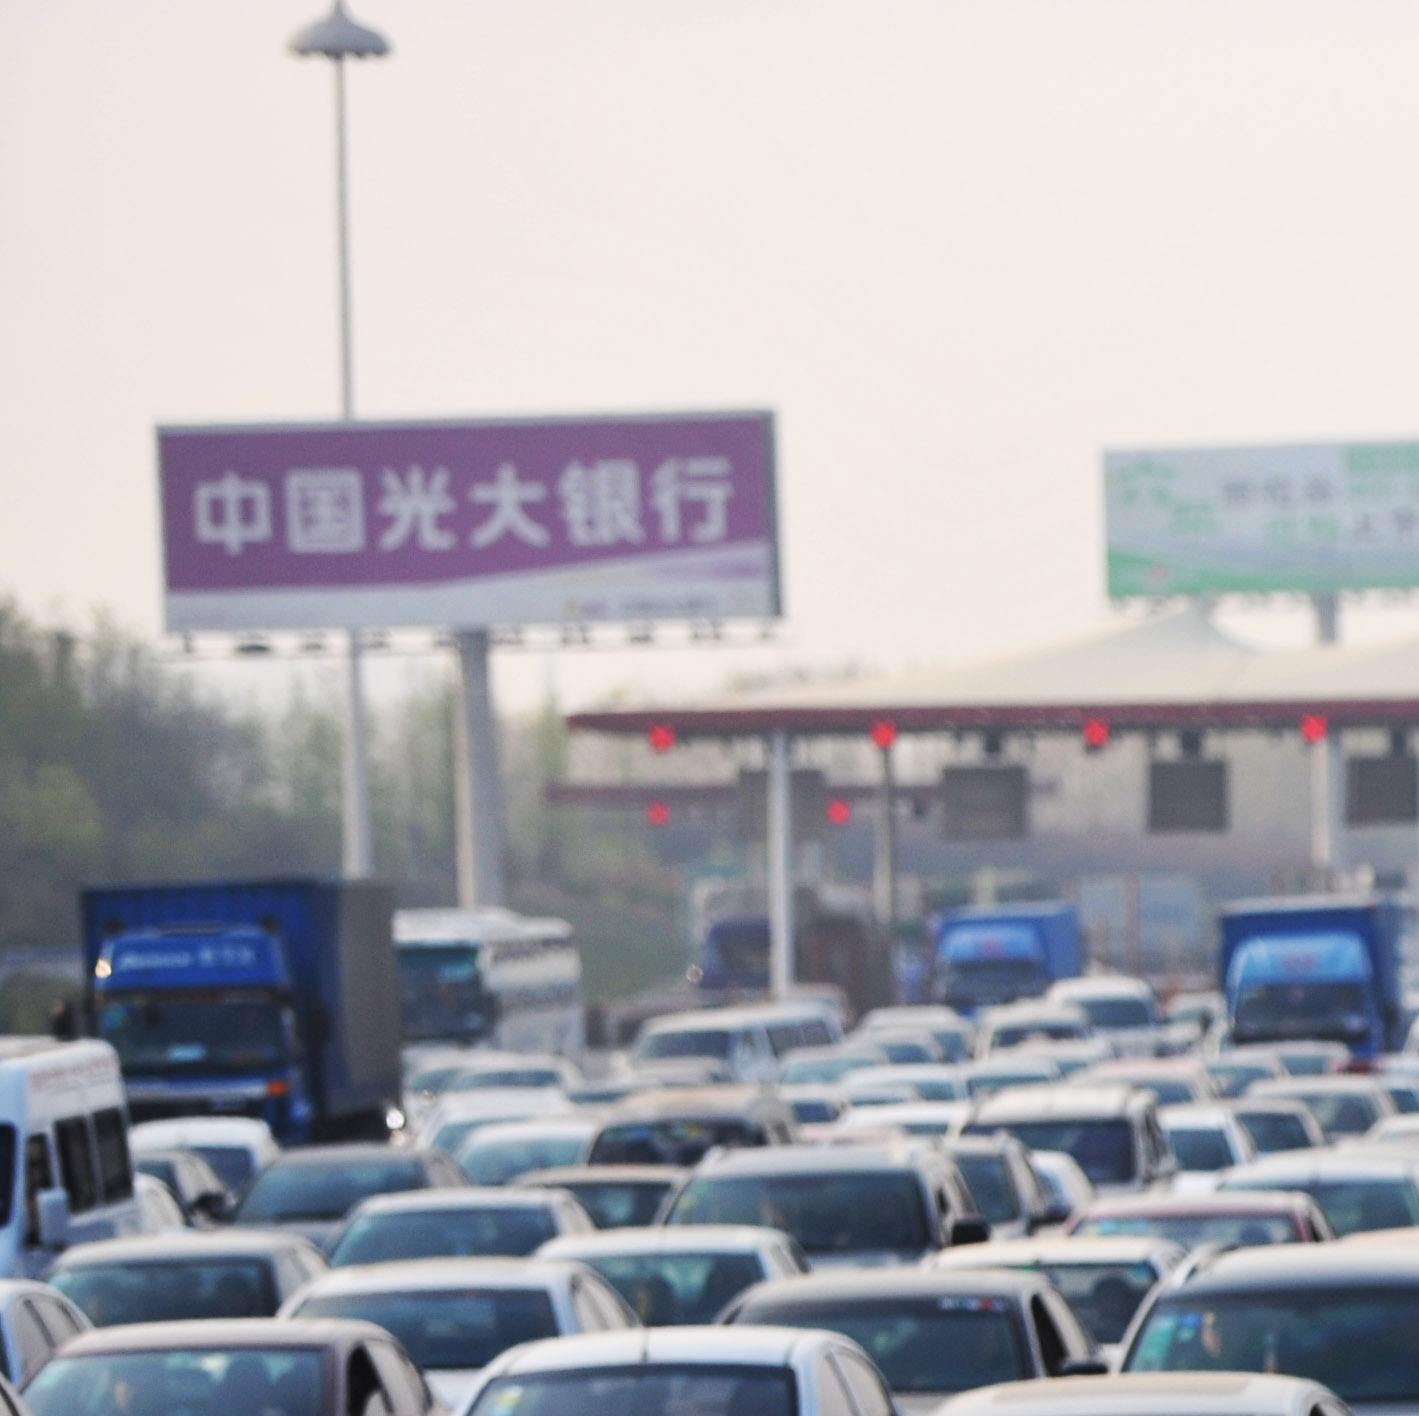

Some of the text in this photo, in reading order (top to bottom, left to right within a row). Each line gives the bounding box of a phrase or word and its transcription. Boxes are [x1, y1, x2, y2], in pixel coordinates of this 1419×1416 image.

[194, 457, 732, 555] 中国光大银行
